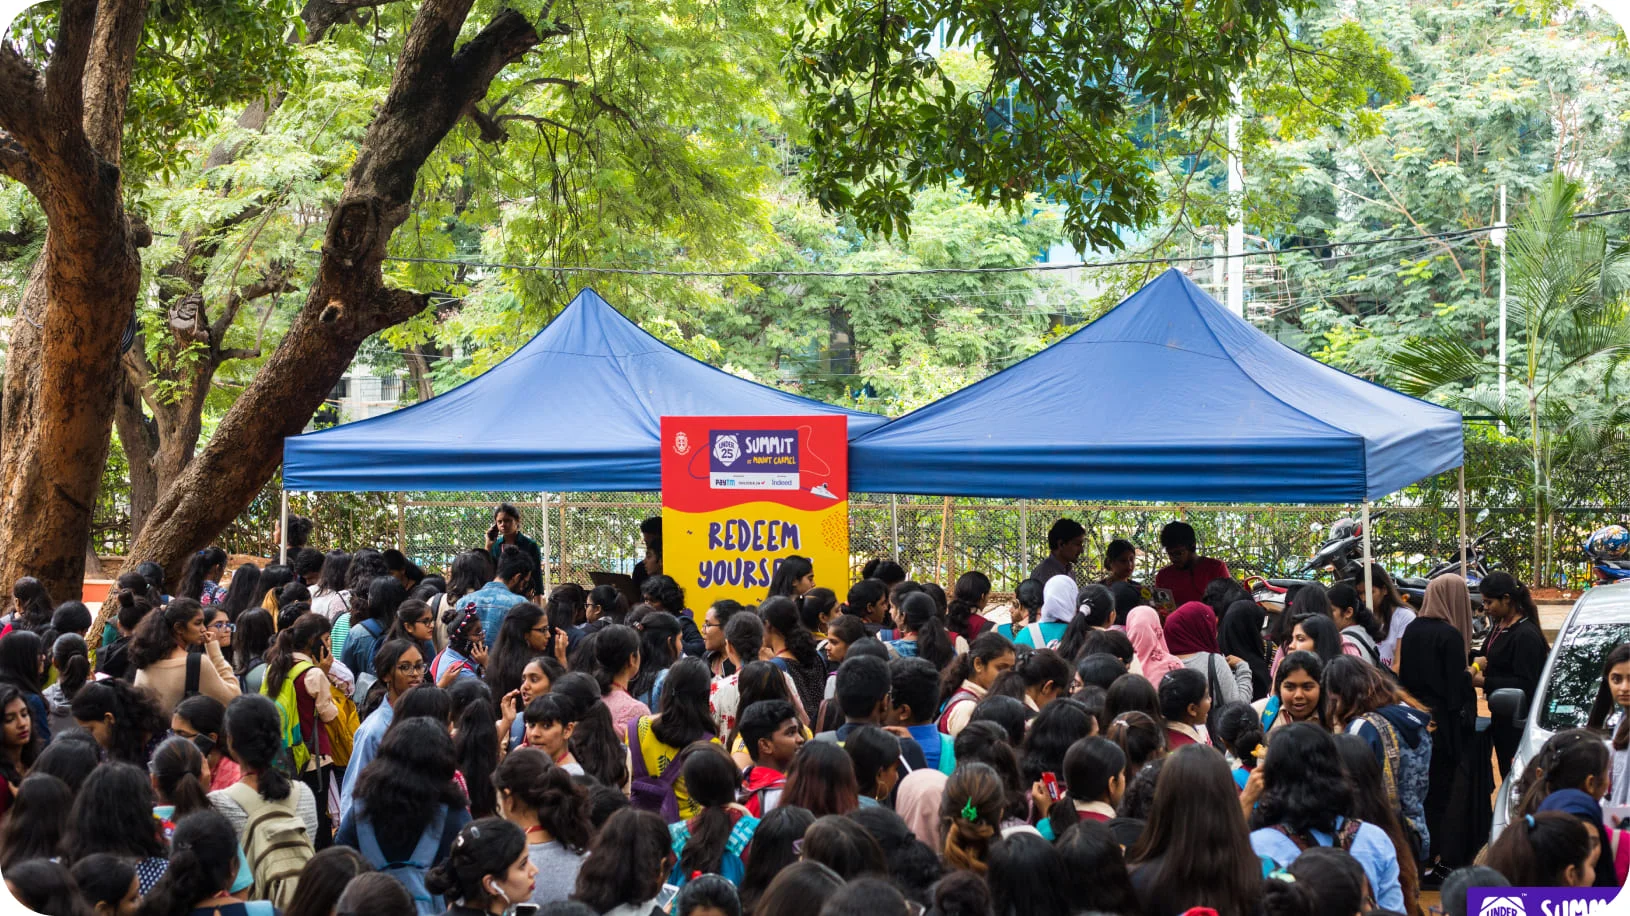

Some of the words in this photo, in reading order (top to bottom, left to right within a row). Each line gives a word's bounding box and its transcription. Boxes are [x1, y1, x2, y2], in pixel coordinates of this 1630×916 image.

[718, 441, 735, 449] UNDER
[745, 436, 794, 454] SUMMIT
[721, 448, 734, 459] 25
[752, 456, 772, 465] MOUNT
[773, 456, 796, 465] CARMEL
[708, 518, 801, 552] REDEEM
[697, 557, 813, 589] YOURS
